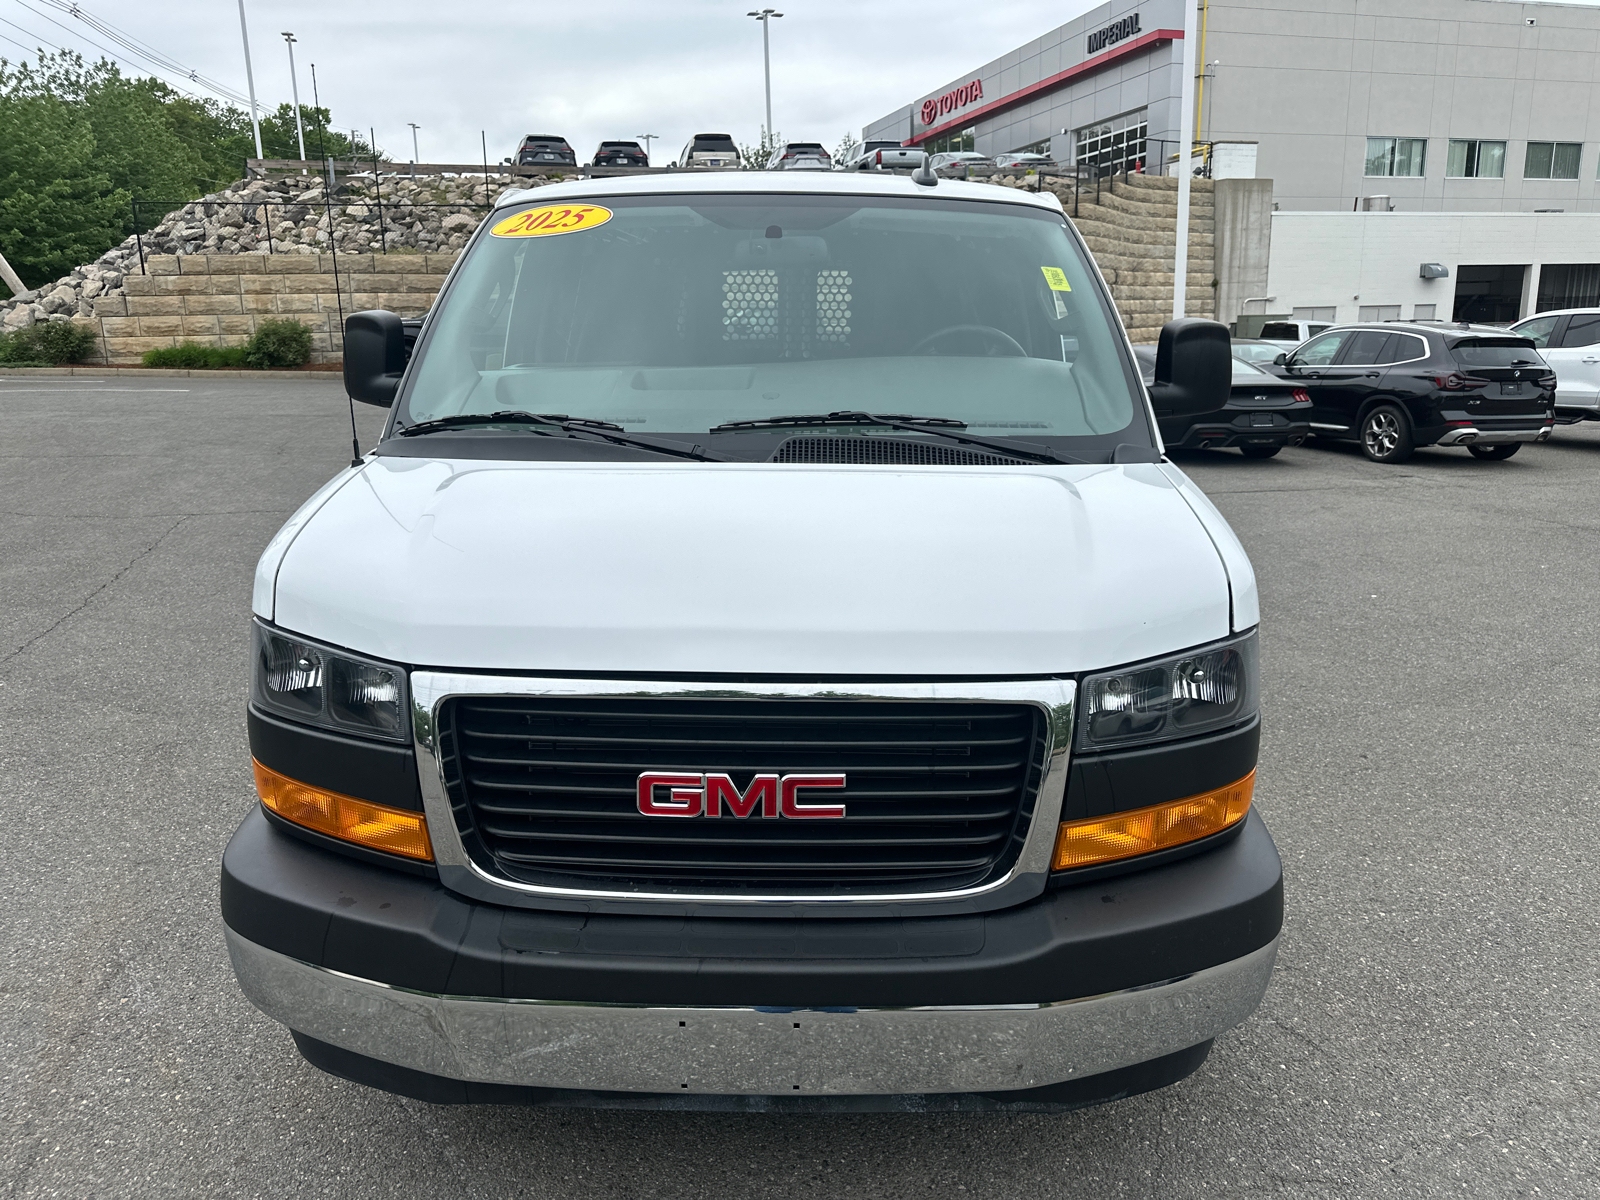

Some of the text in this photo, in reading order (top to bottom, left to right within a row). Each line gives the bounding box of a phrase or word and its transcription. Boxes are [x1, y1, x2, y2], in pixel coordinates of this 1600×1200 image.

[1087, 12, 1142, 54] IMPERIAL
[937, 79, 983, 116] TOYOTA
[504, 208, 595, 234] 2025
[636, 771, 846, 819] GMC
